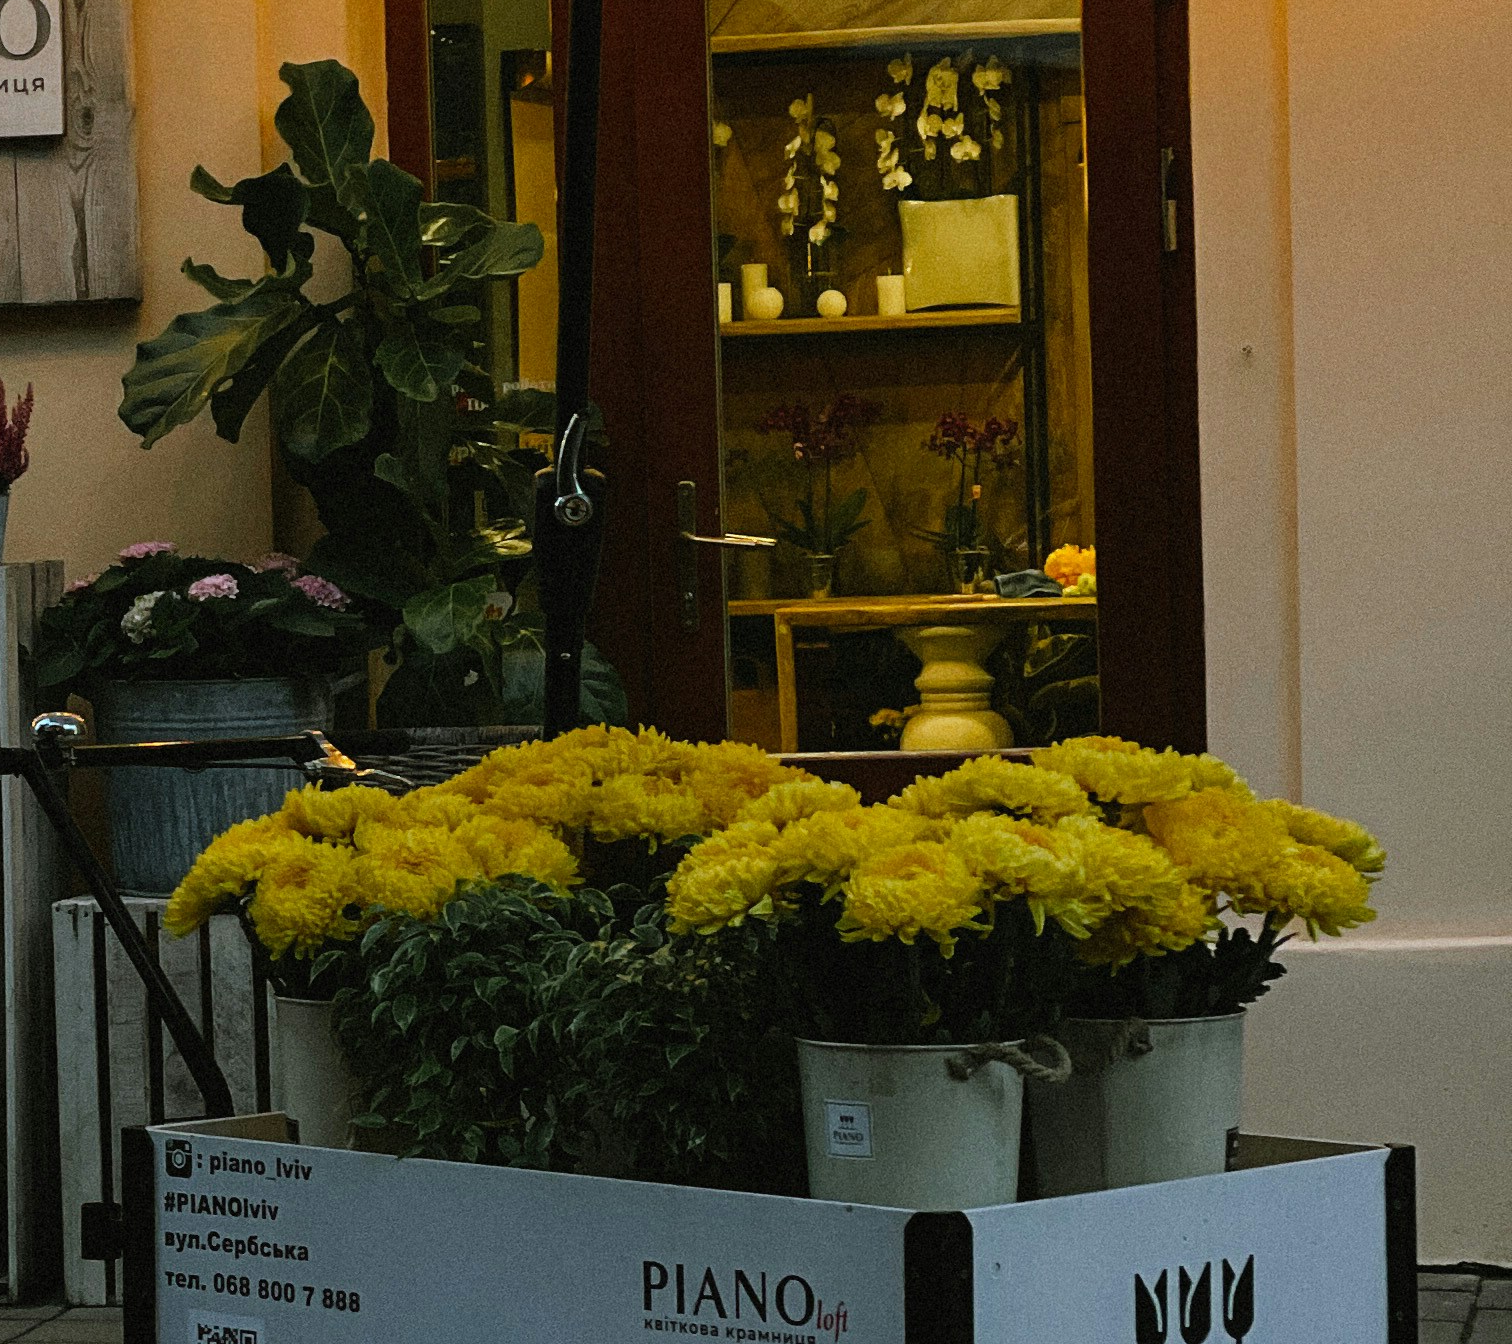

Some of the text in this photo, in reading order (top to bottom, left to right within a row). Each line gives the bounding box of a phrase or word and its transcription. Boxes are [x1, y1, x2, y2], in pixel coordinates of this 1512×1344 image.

[209, 1152, 312, 1181] piano_lviv
[164, 1192, 279, 1221] #PIANOlviv
[164, 1230, 310, 1261] вул.Сербська
[165, 1270, 361, 1313] тел. 068 800 7 888
[643, 1260, 815, 1327] PIANO
[644, 1316, 719, 1337] квіткова
